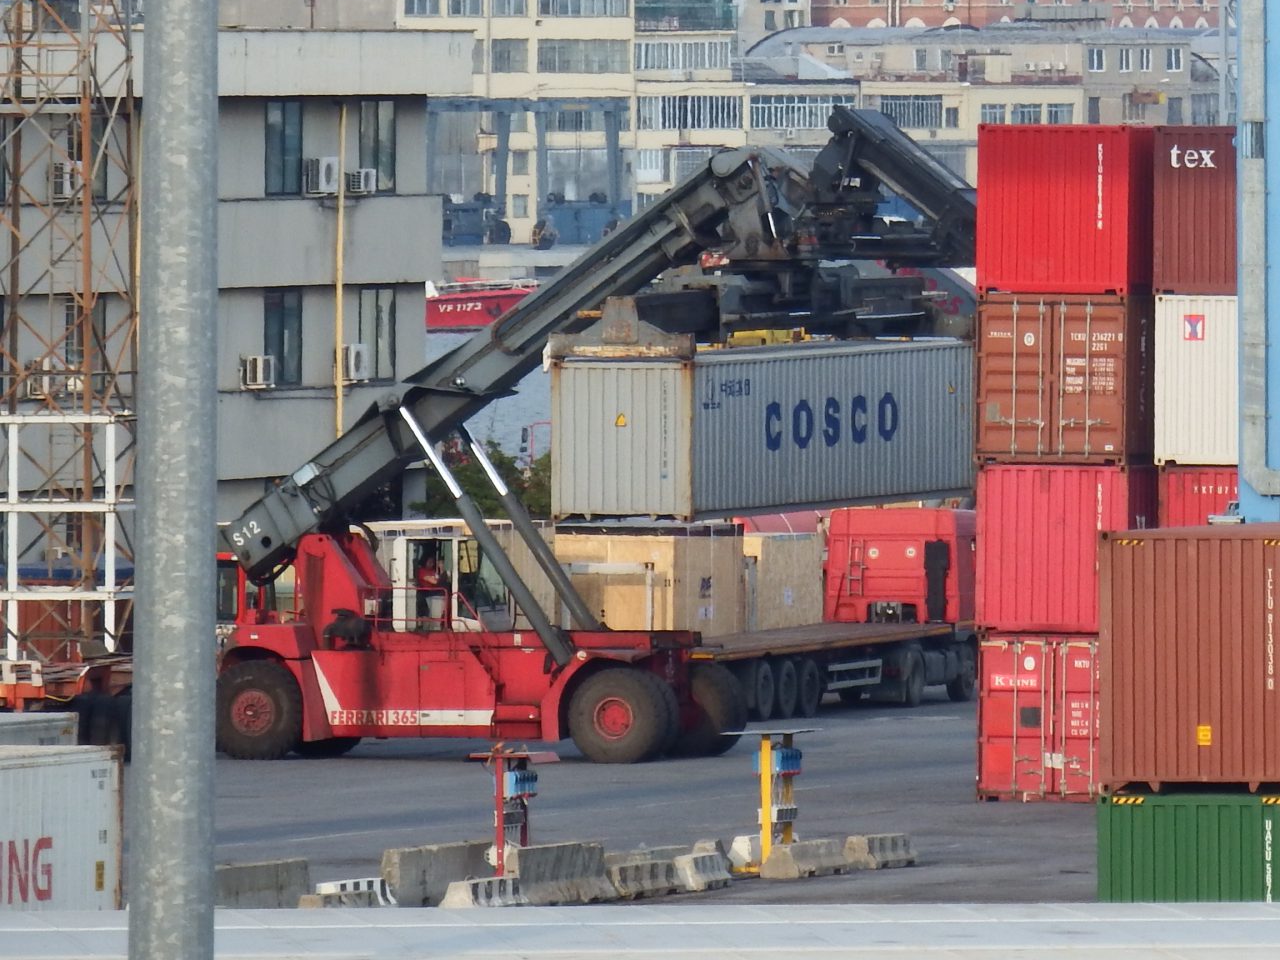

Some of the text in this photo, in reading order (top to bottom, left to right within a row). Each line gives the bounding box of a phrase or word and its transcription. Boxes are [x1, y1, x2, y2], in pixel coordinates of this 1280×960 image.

[1169, 144, 1217, 169] tex
[438, 304, 454, 313] VF
[765, 392, 899, 451] COSCO
[233, 521, 261, 546] S12
[1009, 679, 1037, 687] LINE
[331, 710, 417, 725] FERRARI 365
[1265, 819, 1273, 861] UACU
[0, 837, 53, 905] NG
